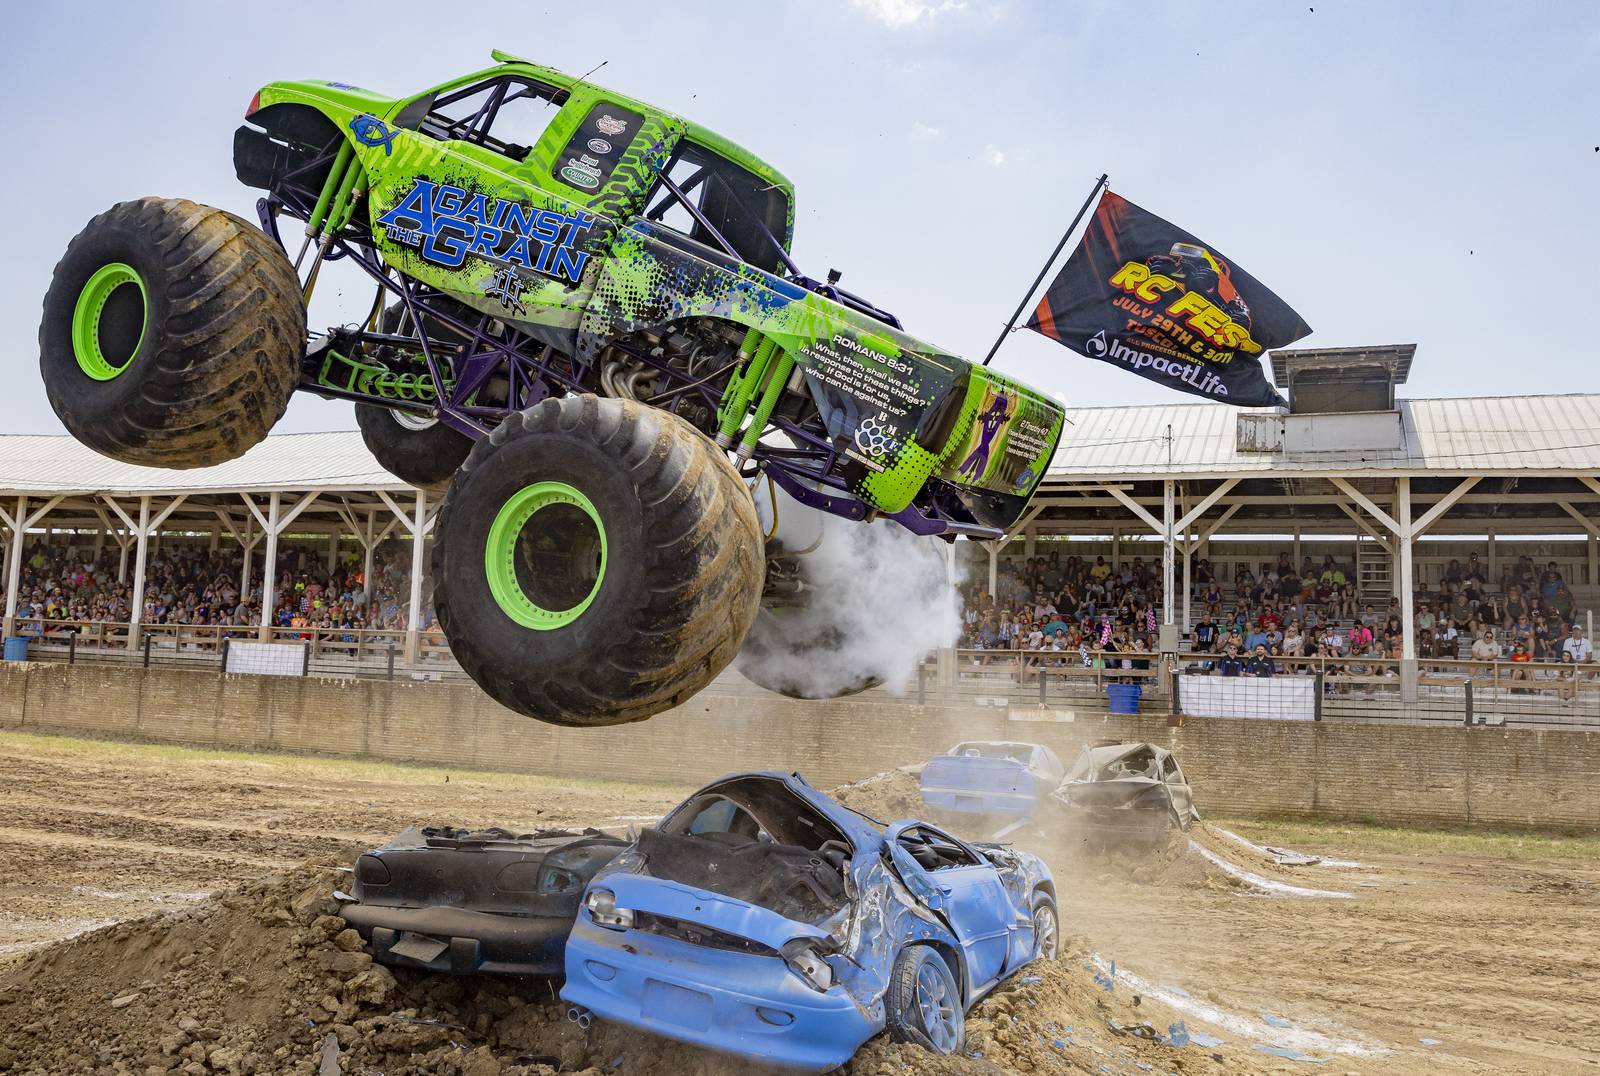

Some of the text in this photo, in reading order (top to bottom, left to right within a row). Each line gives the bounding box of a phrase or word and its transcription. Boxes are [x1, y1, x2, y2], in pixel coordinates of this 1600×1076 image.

[567, 169, 595, 184] COUNTRY
[377, 179, 593, 249] AGAINST
[386, 224, 421, 246] THE
[423, 216, 591, 283] GRAIN
[1108, 261, 1176, 304] RC
[1112, 296, 1154, 319] JULY
[1151, 314, 1193, 345] 29TH
[815, 342, 920, 395] What, then, shall we say
[833, 334, 914, 376] ROMANS 8:31
[1109, 338, 1229, 395] ImpactLife
[1141, 341, 1176, 359] PROCEEDS
[805, 366, 908, 417] who can be against us?
[810, 351, 852, 374] response
[852, 369, 863, 379] to
[864, 374, 890, 391] these
[890, 385, 926, 408] things?
[835, 369, 854, 384] God
[853, 377, 861, 387] is
[862, 382, 877, 394] for
[877, 391, 891, 403] us,
[878, 411, 888, 421] B
[887, 424, 897, 436] M
